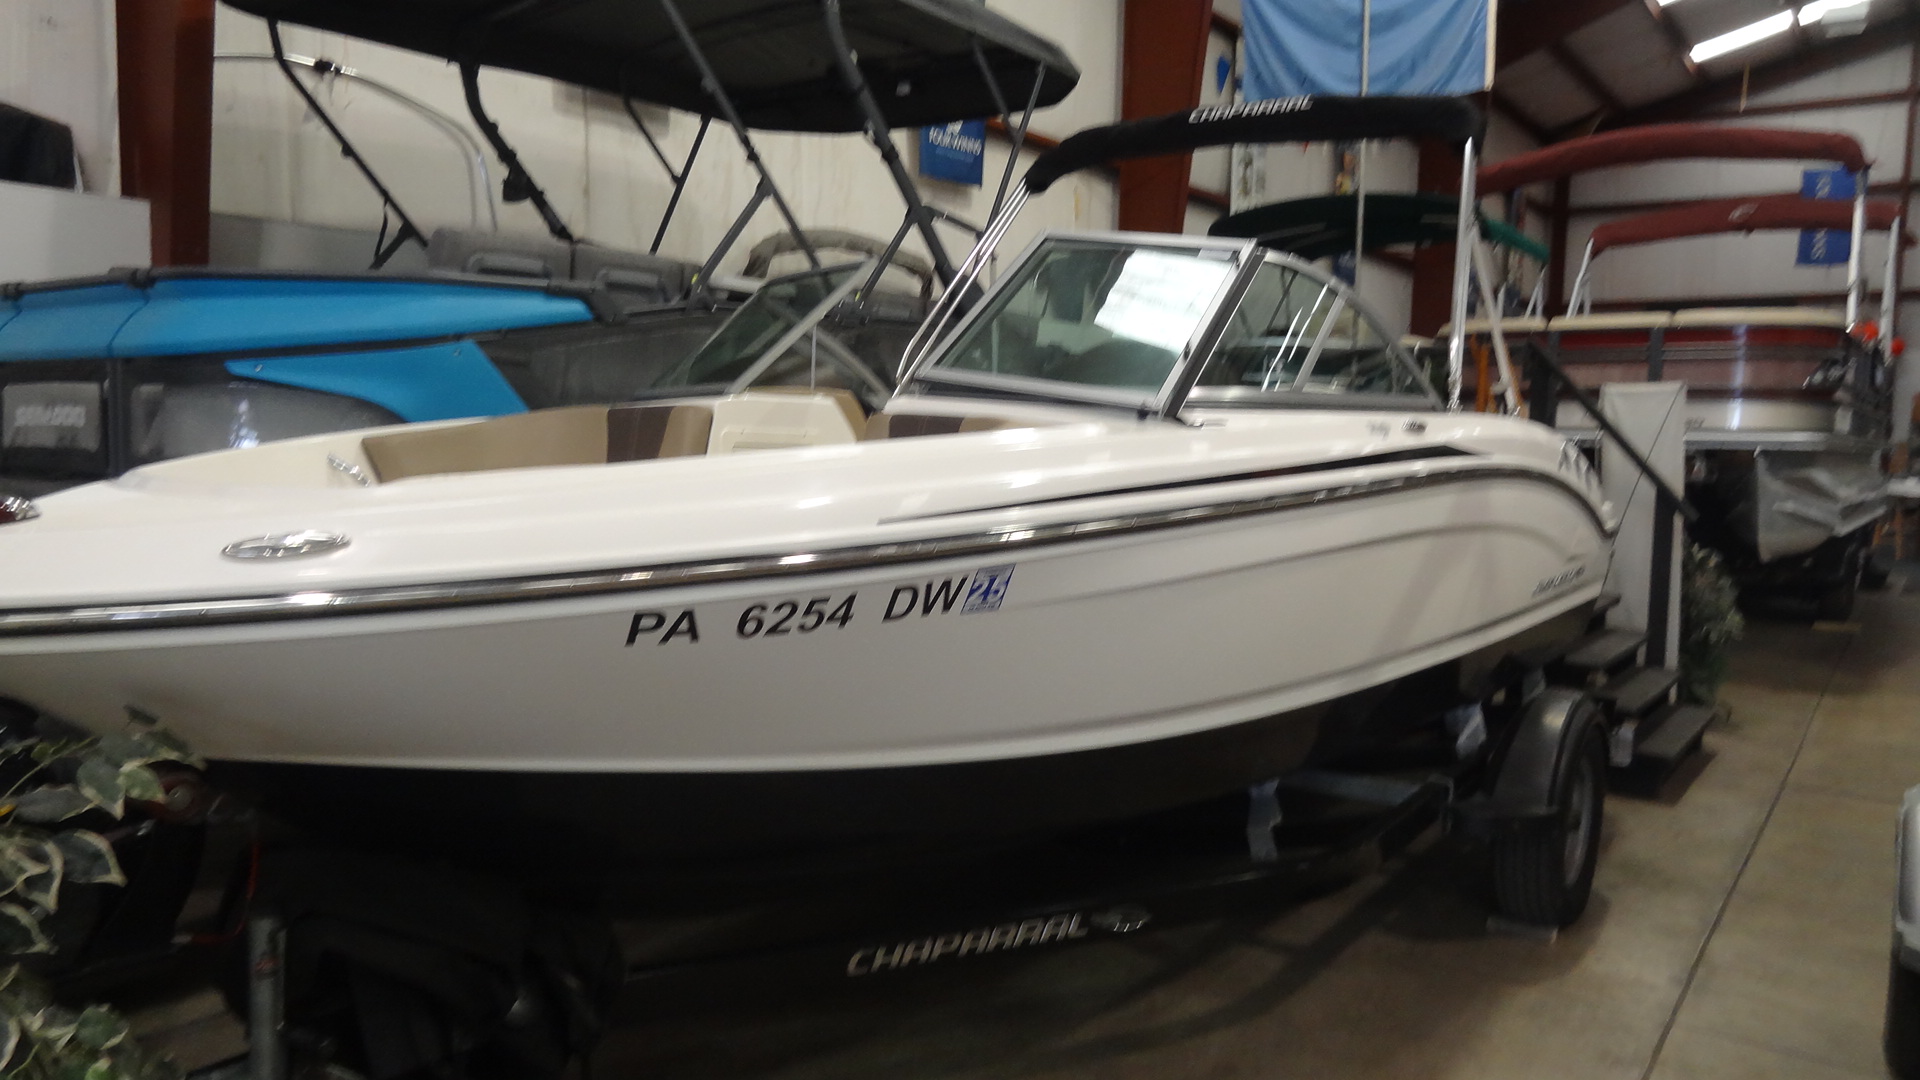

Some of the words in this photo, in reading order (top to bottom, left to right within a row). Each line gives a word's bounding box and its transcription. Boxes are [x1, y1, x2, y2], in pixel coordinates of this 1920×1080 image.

[1188, 93, 1313, 124] CHAPARRAL
[624, 609, 700, 647] PA
[736, 591, 858, 640] 6254
[882, 574, 968, 623] DW
[846, 911, 1088, 977] CHAPARRAL
